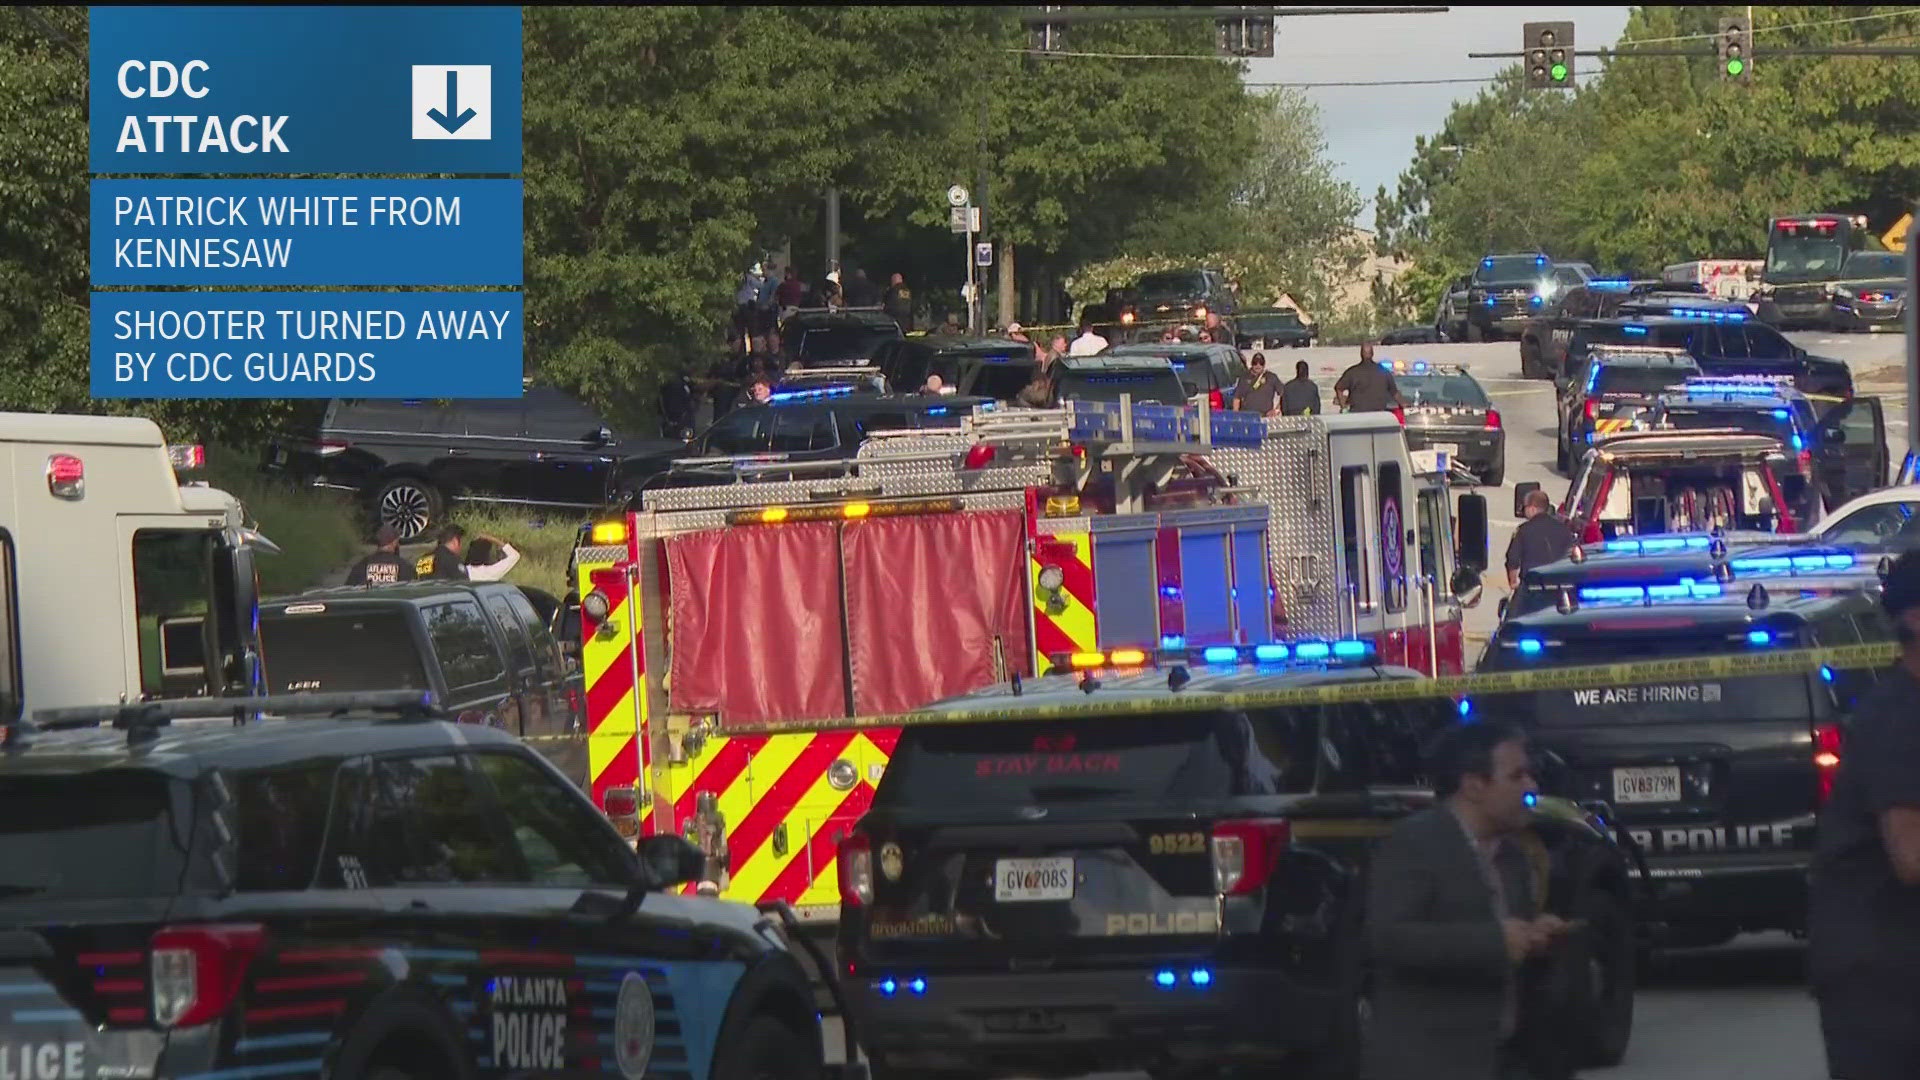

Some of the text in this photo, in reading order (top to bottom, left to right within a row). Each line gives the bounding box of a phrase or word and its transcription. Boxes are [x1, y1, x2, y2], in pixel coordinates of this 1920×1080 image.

[367, 563, 399, 575] ATLANTA
[367, 574, 398, 583] POLICE
[1574, 684, 1700, 706] WE ARE HIRING
[975, 753, 1121, 777] STAY BACK
[1660, 824, 1793, 850] POLICE
[343, 869, 369, 889] 911
[1007, 868, 1068, 890] GV6208S
[1105, 912, 1217, 936] POLICE
[493, 977, 567, 1006] ATLANTA
[493, 1011, 567, 1069] POLICE
[0, 1041, 85, 1080] LICE
